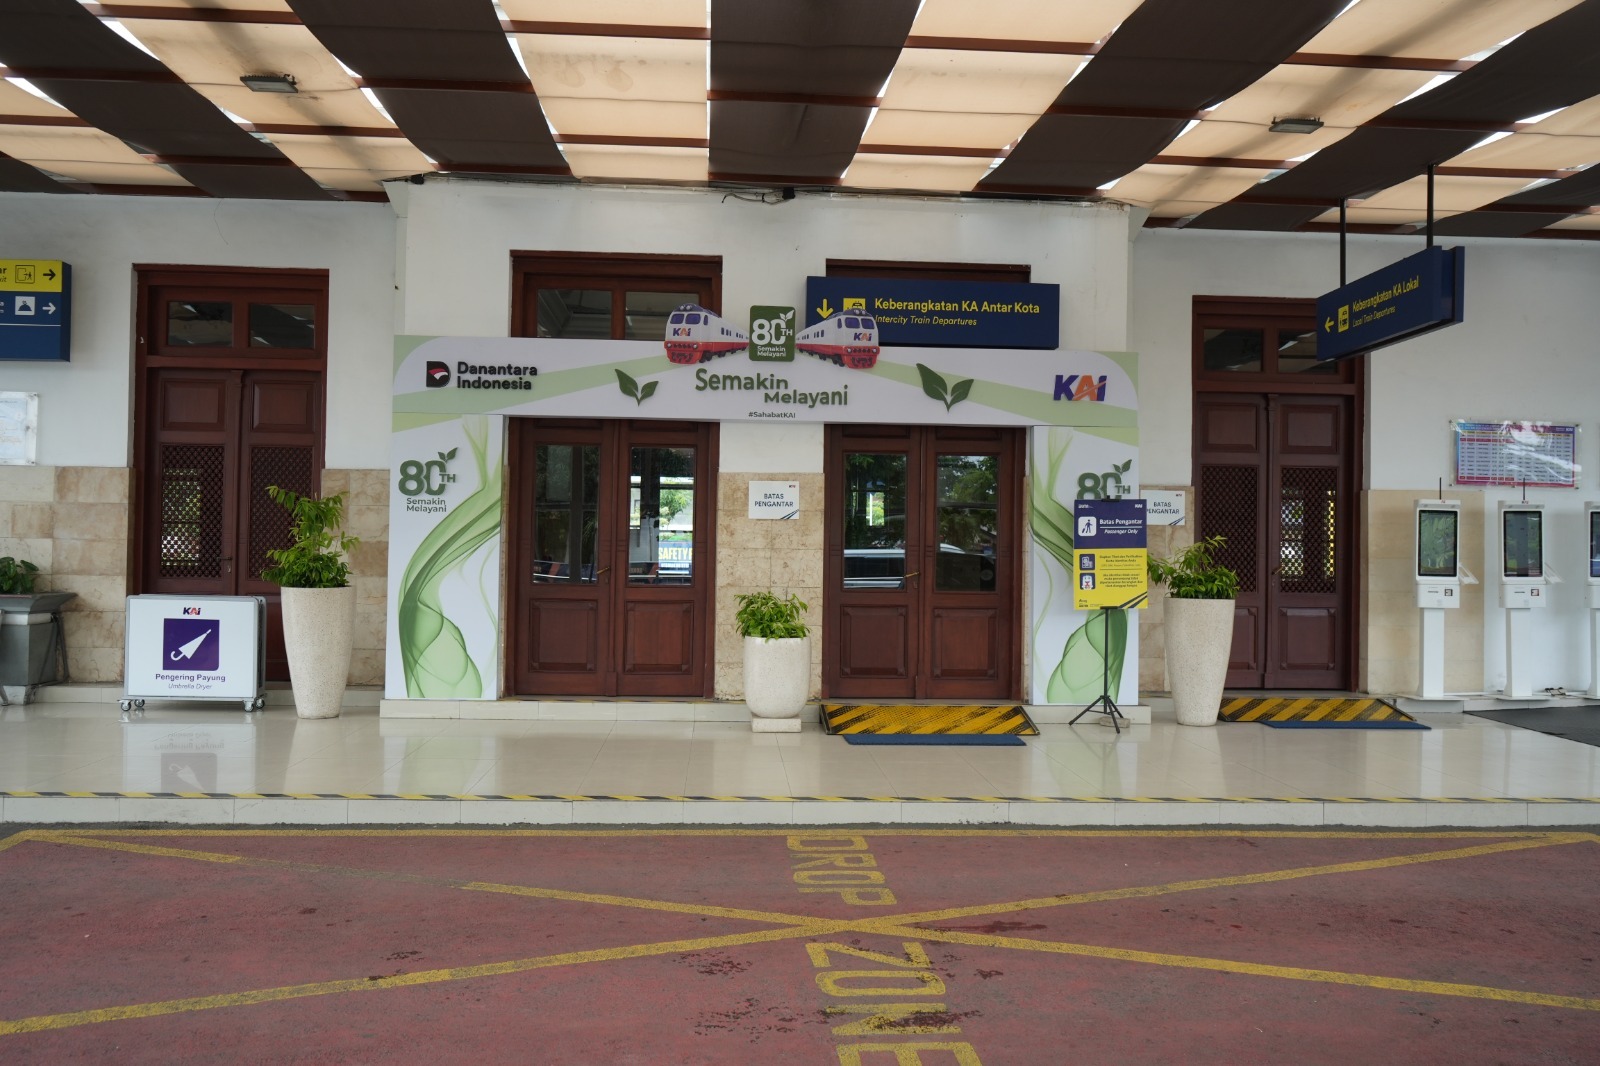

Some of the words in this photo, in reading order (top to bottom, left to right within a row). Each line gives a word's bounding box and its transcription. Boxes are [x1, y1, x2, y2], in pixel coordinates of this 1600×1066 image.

[1393, 282, 1403, 297] KA
[1403, 275, 1419, 293] Lokal
[875, 298, 959, 313] Keberangkatan
[962, 301, 979, 312] KA
[981, 301, 1012, 313] Antar
[1014, 302, 1040, 313] Kota
[875, 315, 908, 325] Intercity
[910, 315, 930, 324] Train
[932, 316, 977, 326] Departures
[457, 361, 538, 376] Danantara
[456, 376, 532, 390] Indonesia
[695, 368, 789, 390] Semakin
[1053, 374, 1108, 402] KAI
[764, 385, 849, 408] Melayani
[748, 411, 796, 419] #SahabatKAI
[406, 497, 446, 505] Semakin
[406, 505, 447, 514] Melayani
[658, 547, 688, 560] SAFETY
[155, 673, 195, 682] Pengering
[196, 674, 226, 682] Payung
[787, 835, 898, 906] DROP
[805, 941, 983, 1066] ZONE
